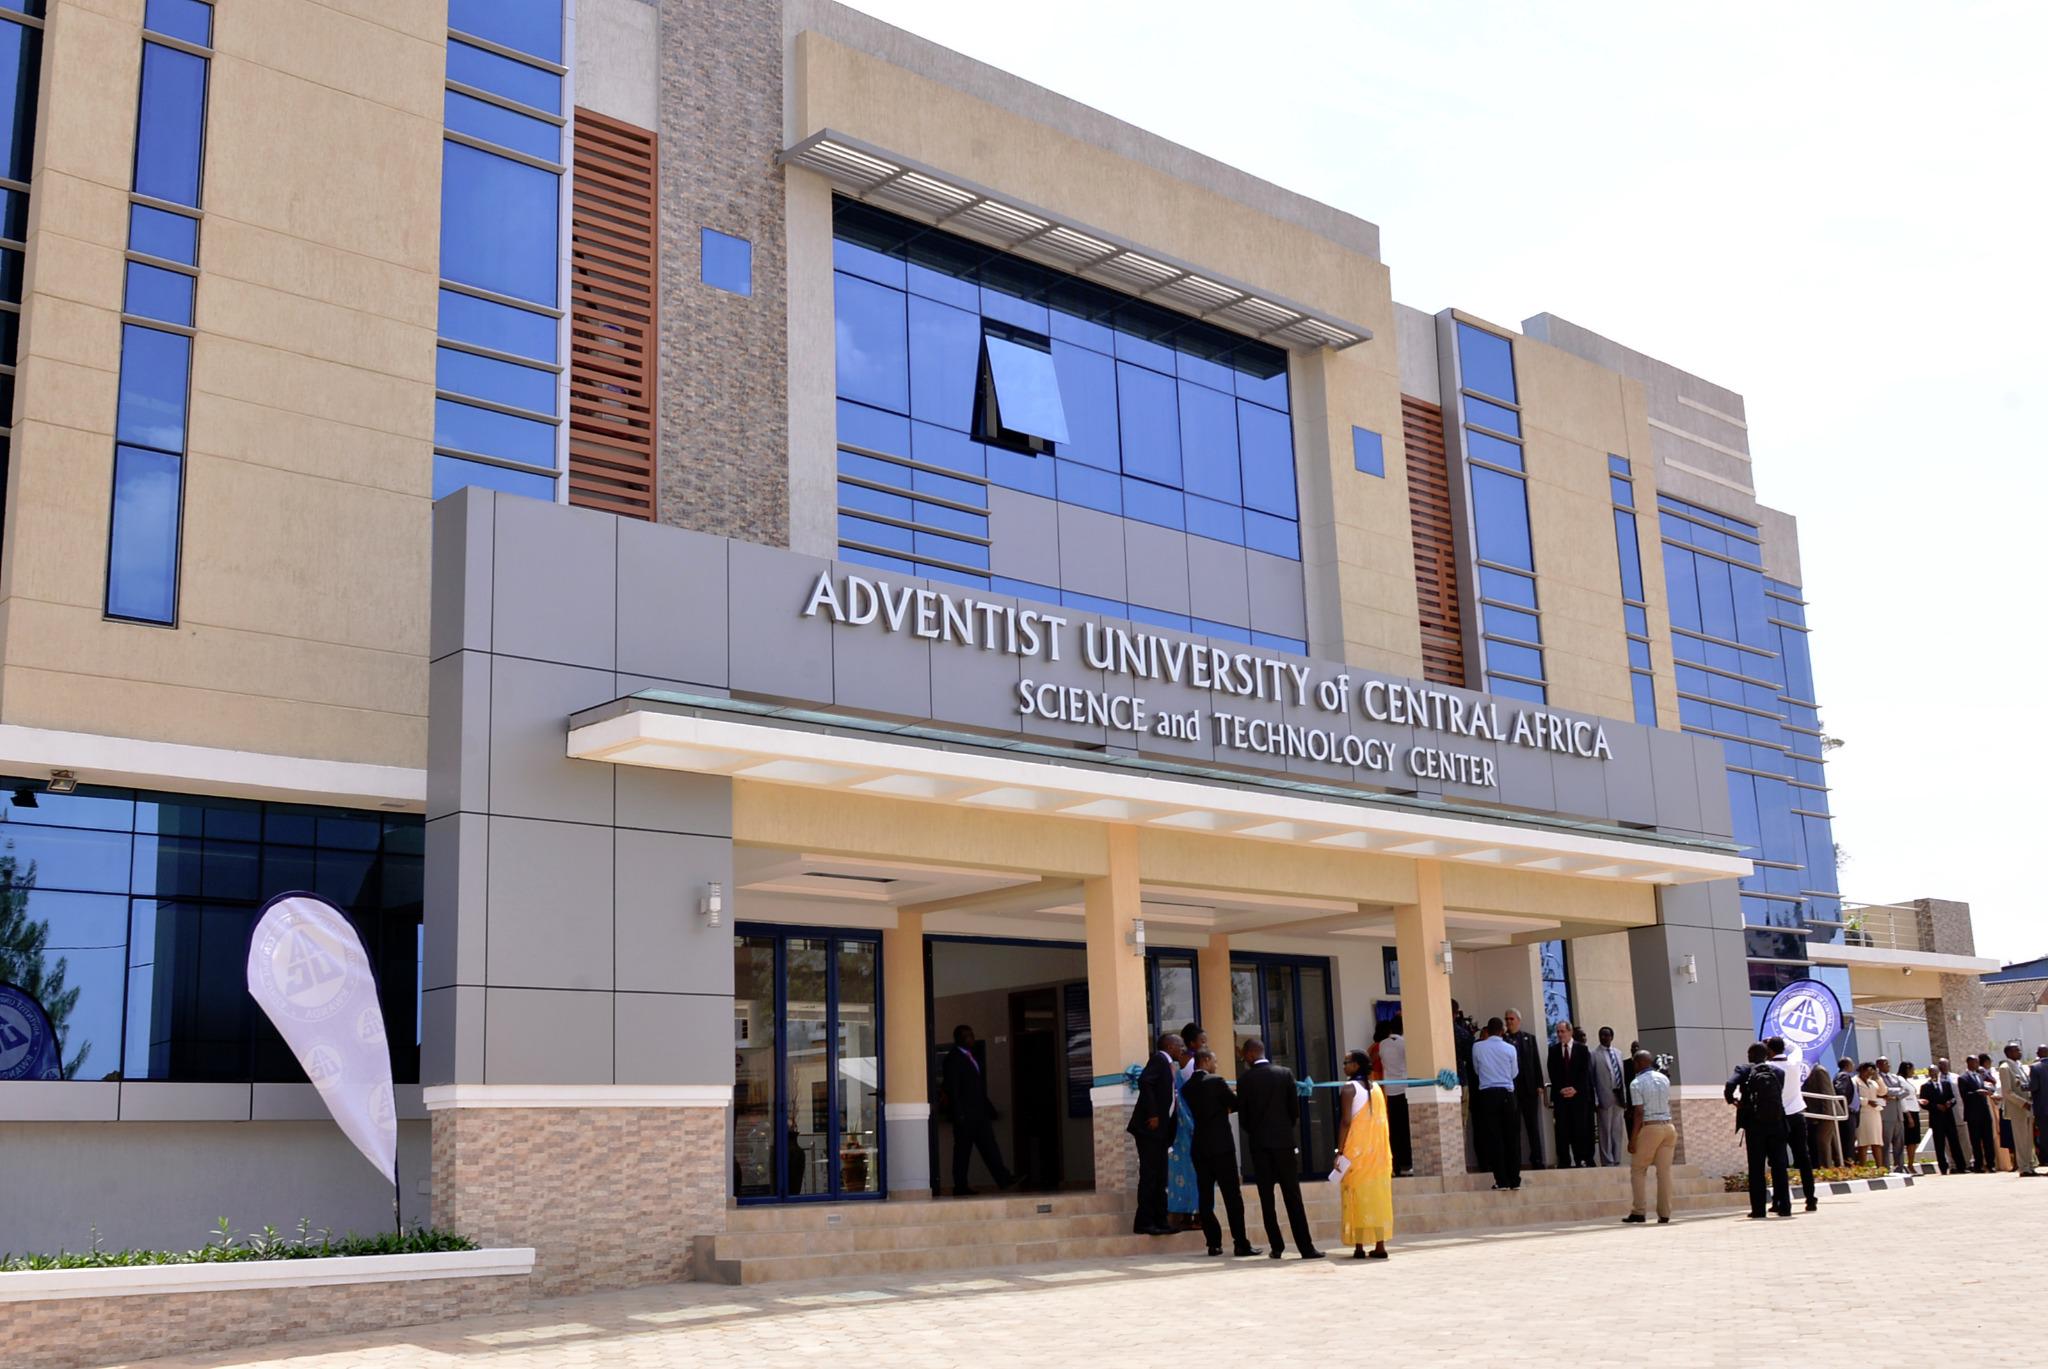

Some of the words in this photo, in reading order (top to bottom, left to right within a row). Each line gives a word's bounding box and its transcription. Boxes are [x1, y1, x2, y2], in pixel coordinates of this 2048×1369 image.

[803, 570, 1066, 661] ADVENTIST
[1083, 621, 1310, 706] UNIVERSITY
[1319, 674, 1349, 713] of
[1362, 680, 1506, 742] CENTRAL
[1513, 709, 1614, 760] AFRICA
[1018, 679, 1148, 732] SCIENCE
[1157, 709, 1200, 741] and
[1214, 711, 1396, 772] TECHNOLOGY
[1408, 746, 1497, 787] CENTER
